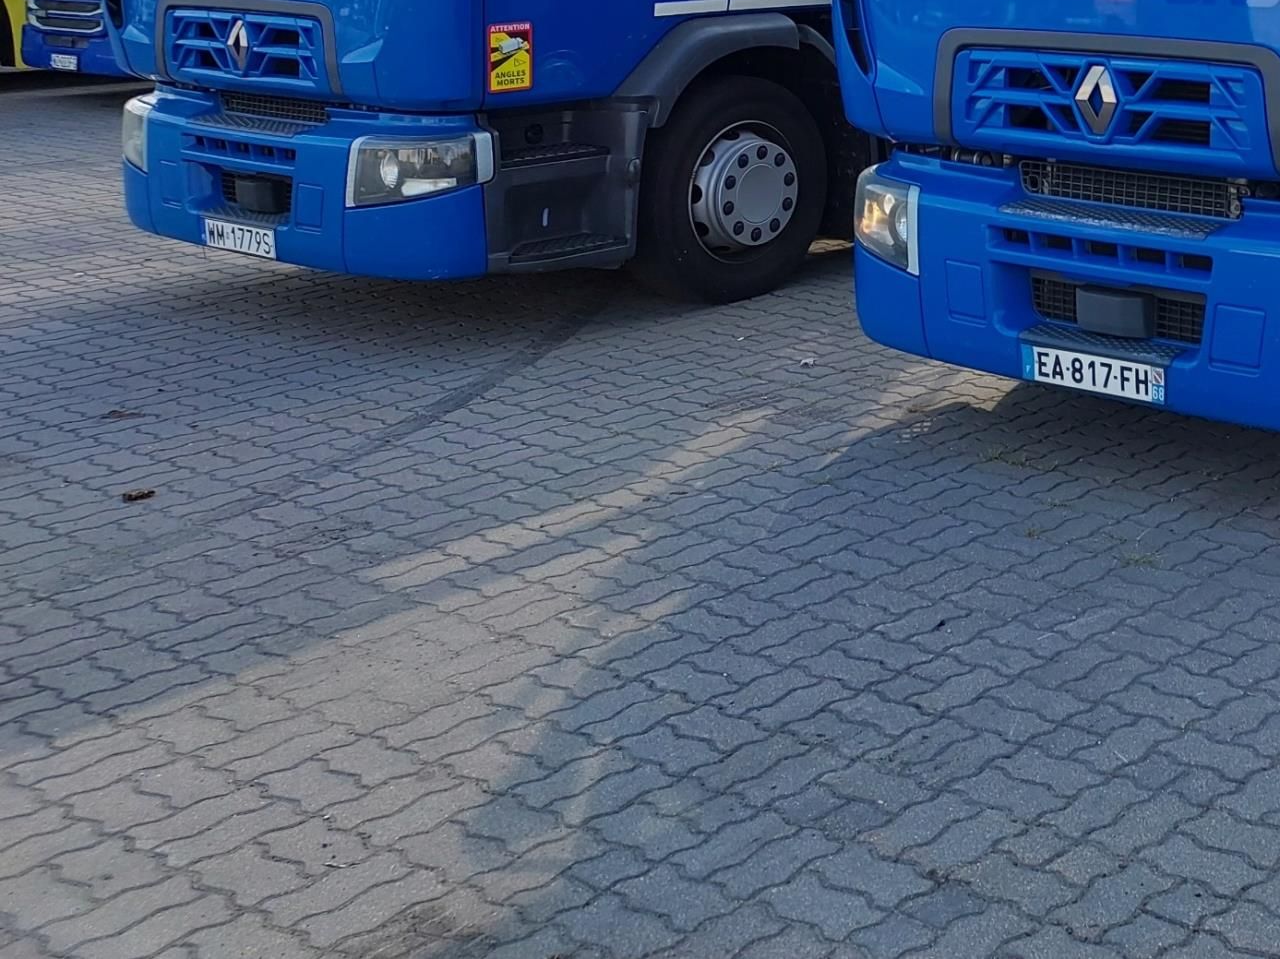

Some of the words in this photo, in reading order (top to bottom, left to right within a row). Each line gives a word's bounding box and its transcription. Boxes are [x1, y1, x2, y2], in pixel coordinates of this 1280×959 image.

[490, 24, 530, 33] ATTENTION
[495, 69, 527, 79] ANGLES
[496, 77, 525, 87] MORTS
[1152, 386, 1165, 401] 68
